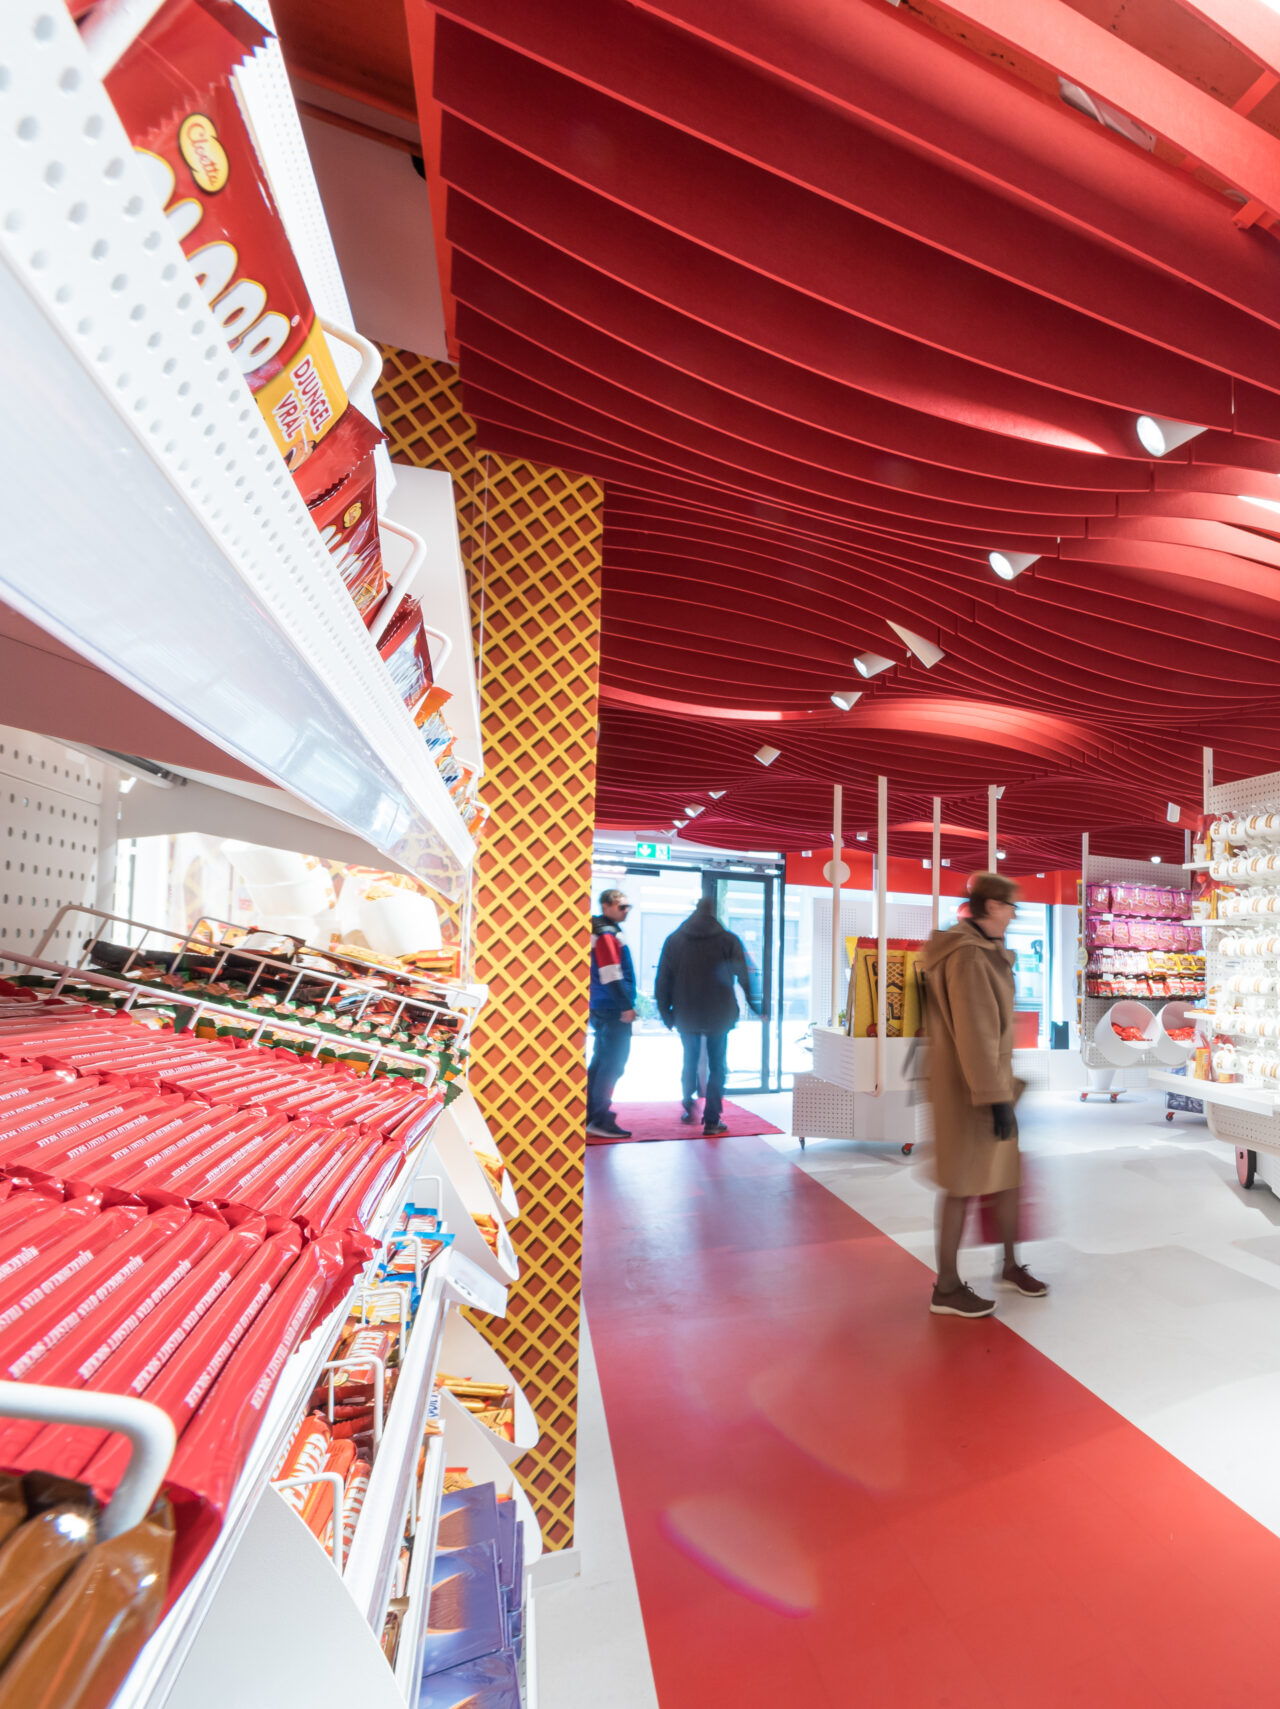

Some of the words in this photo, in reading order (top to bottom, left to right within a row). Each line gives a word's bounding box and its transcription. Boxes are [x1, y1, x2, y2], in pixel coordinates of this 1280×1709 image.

[185, 122, 219, 188] Cloetta
[273, 391, 309, 441] VRÅL
[290, 355, 332, 433] DJUNGEL
[343, 1331, 385, 1370] CNTER
